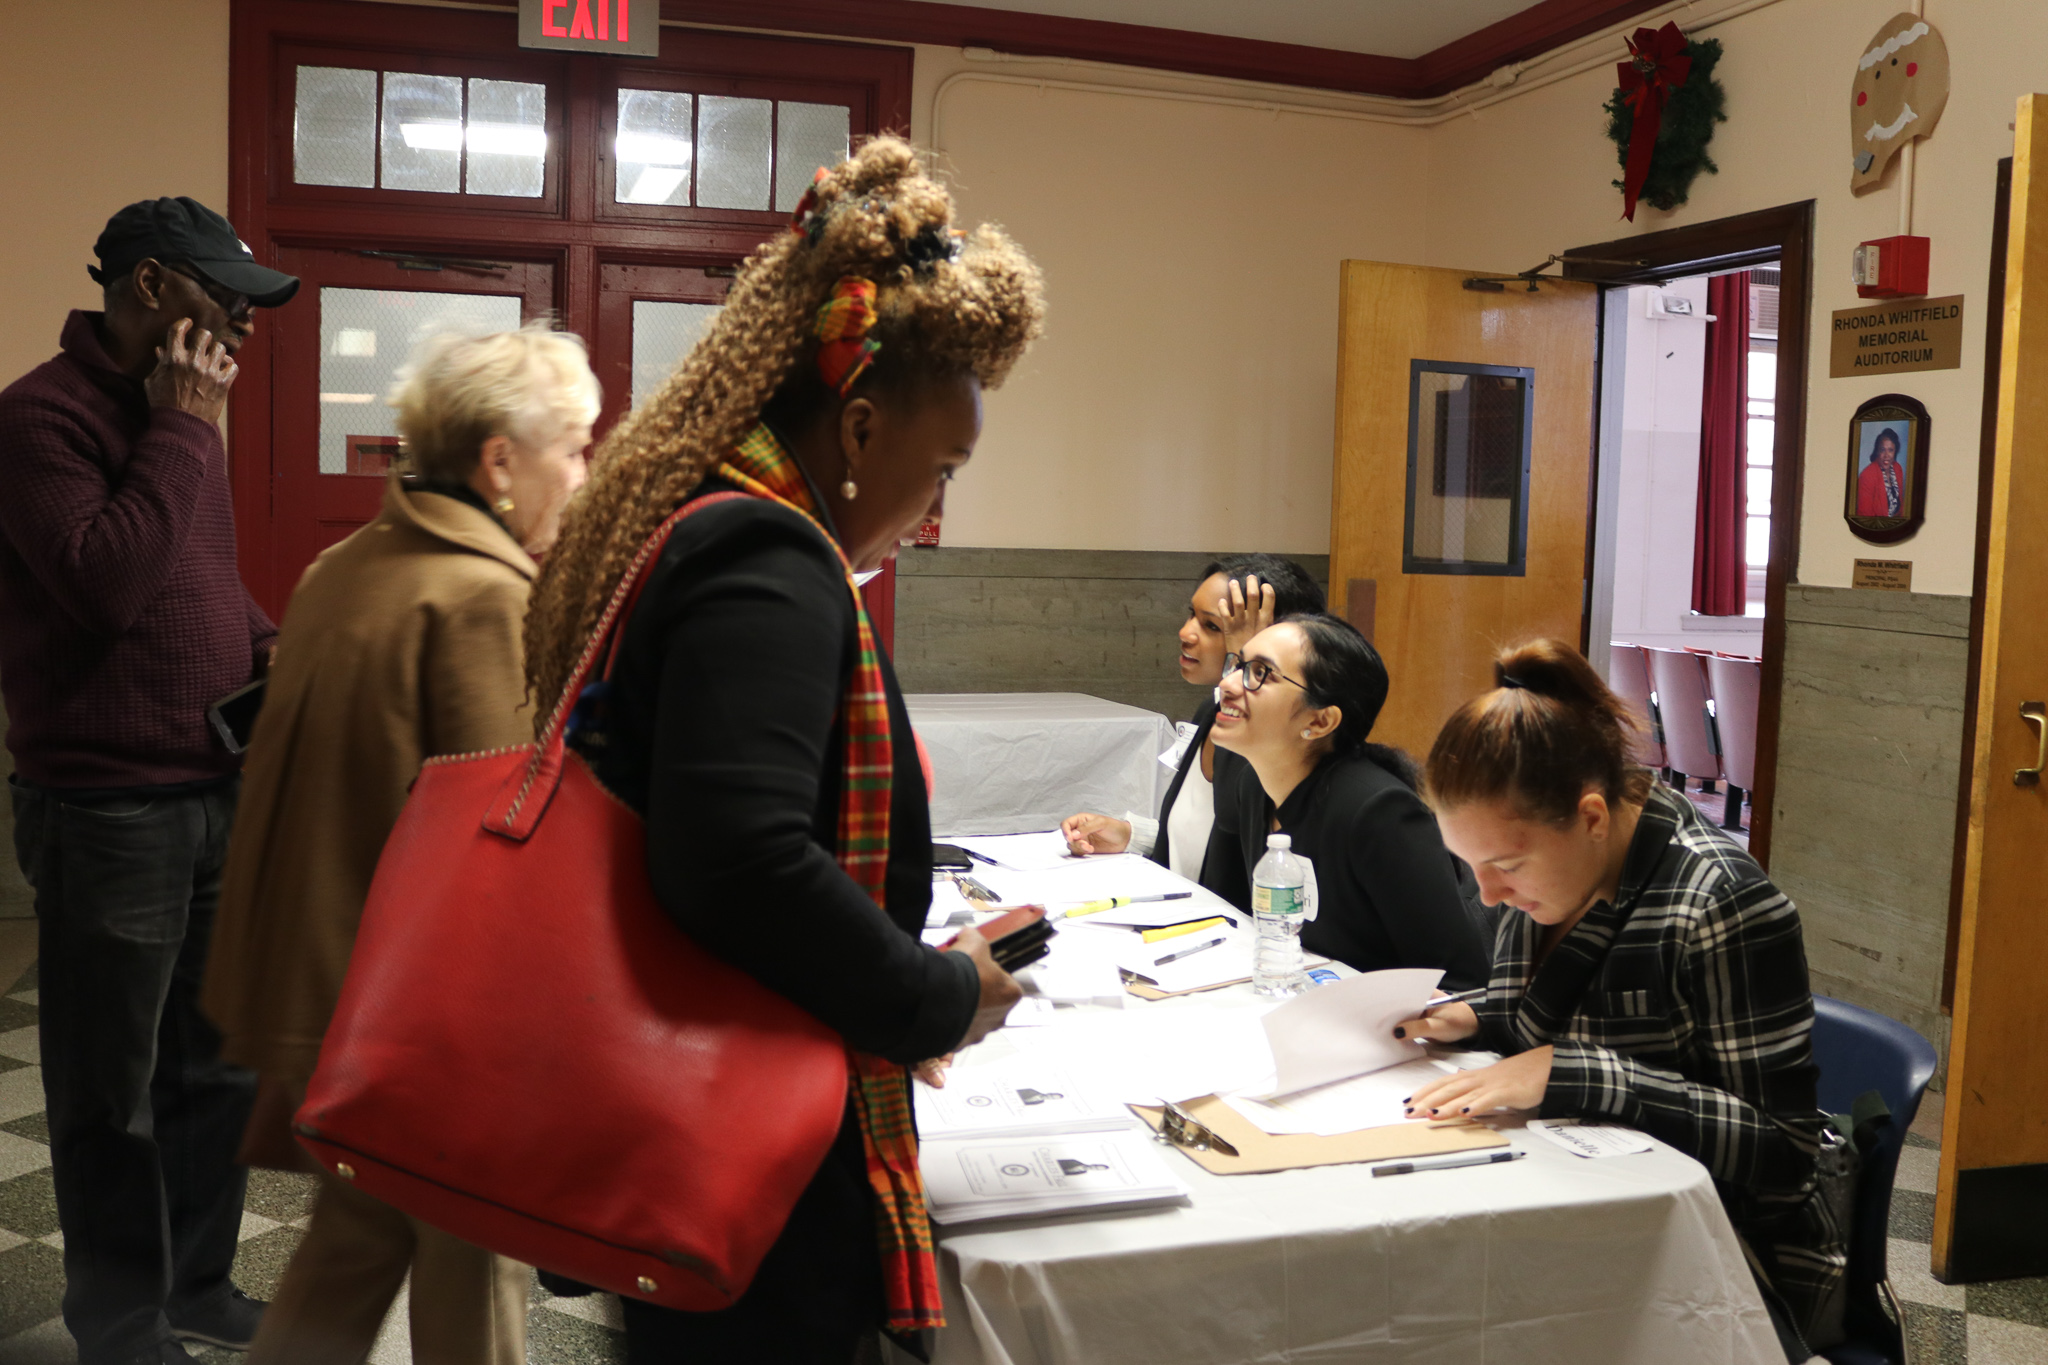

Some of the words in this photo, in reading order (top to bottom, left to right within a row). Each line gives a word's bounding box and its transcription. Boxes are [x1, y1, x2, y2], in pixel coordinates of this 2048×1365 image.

[1834, 314, 1885, 331] RHONDA
[1889, 305, 1959, 325] WHITFIELD
[1858, 329, 1929, 348] MEMORIAL
[1854, 348, 1933, 367] AUDITORIUM
